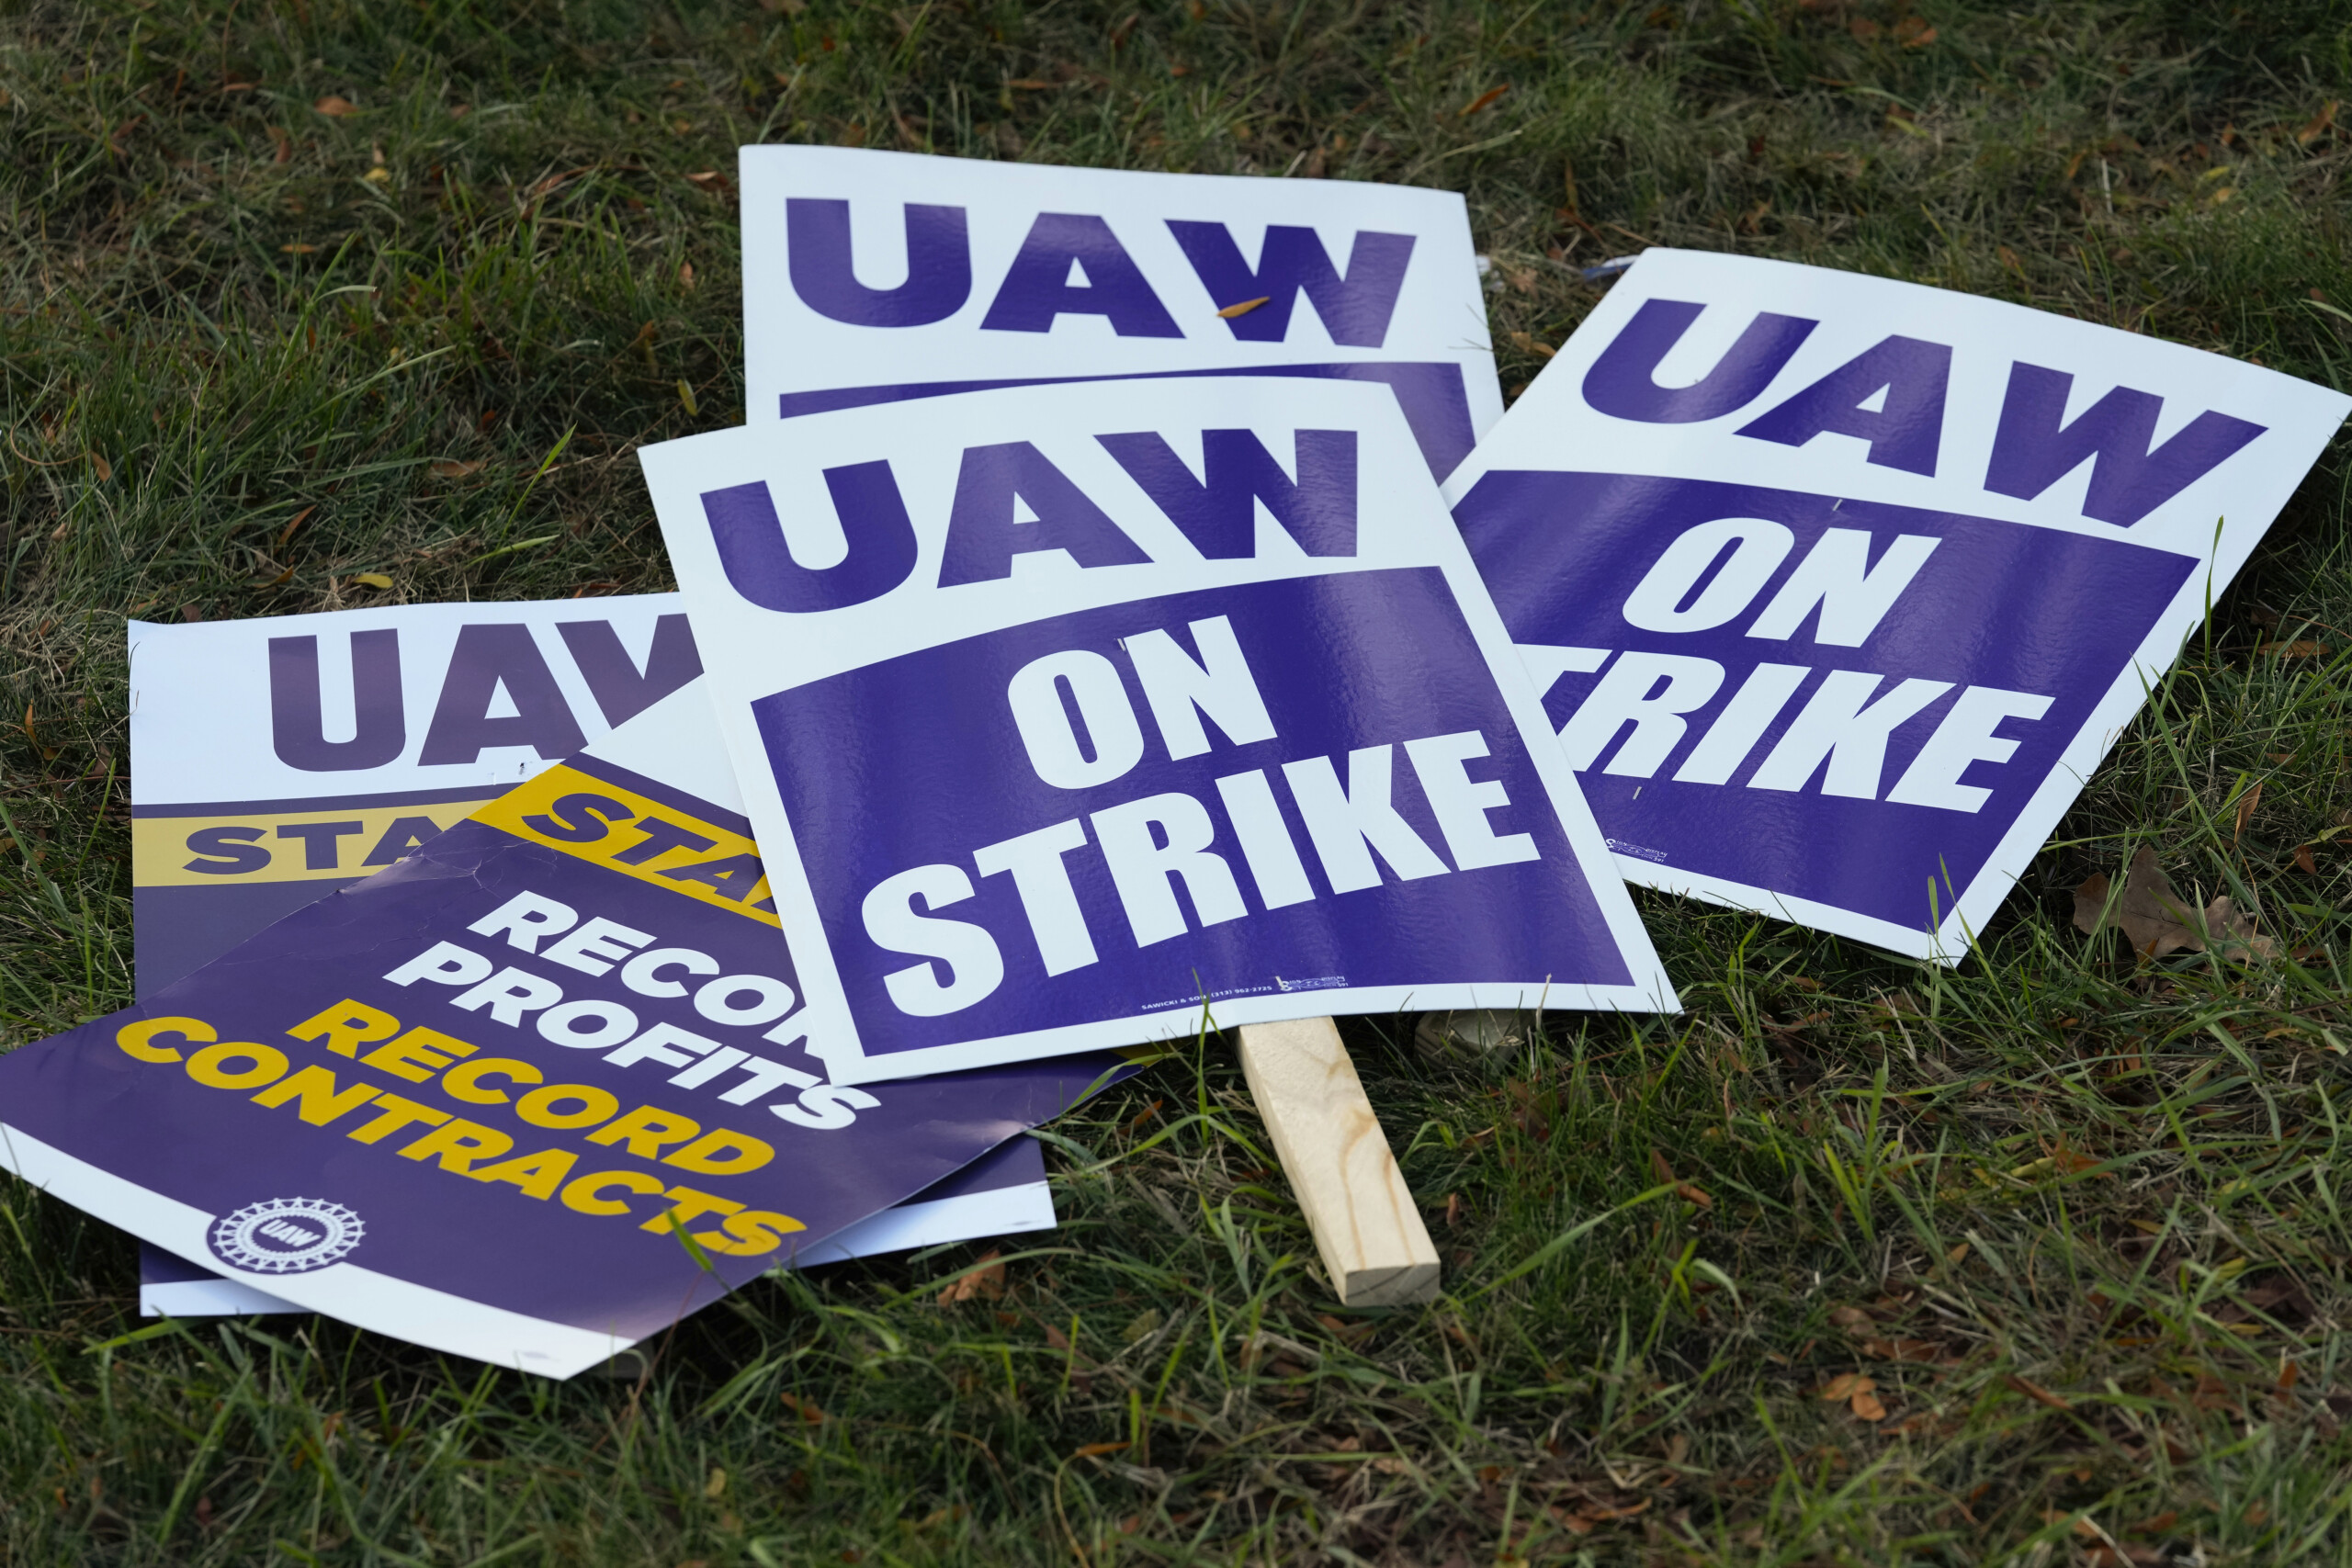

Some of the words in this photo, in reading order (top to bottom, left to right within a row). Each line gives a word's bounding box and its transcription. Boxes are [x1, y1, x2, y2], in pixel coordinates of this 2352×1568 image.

[786, 197, 1418, 348] UAW
[1581, 298, 2269, 528] UAW
[699, 428, 1359, 614] UAW
[1623, 516, 1943, 648] ON
[1007, 614, 1278, 790] ON
[861, 729, 1543, 1018] STRIKE
[286, 998, 776, 1176] RECORD
[382, 940, 882, 1130] PROFITS
[1141, 998, 1179, 1010] SAWICKI
[116, 1016, 808, 1257] CONTRACTS
[259, 1218, 322, 1247] UAW
